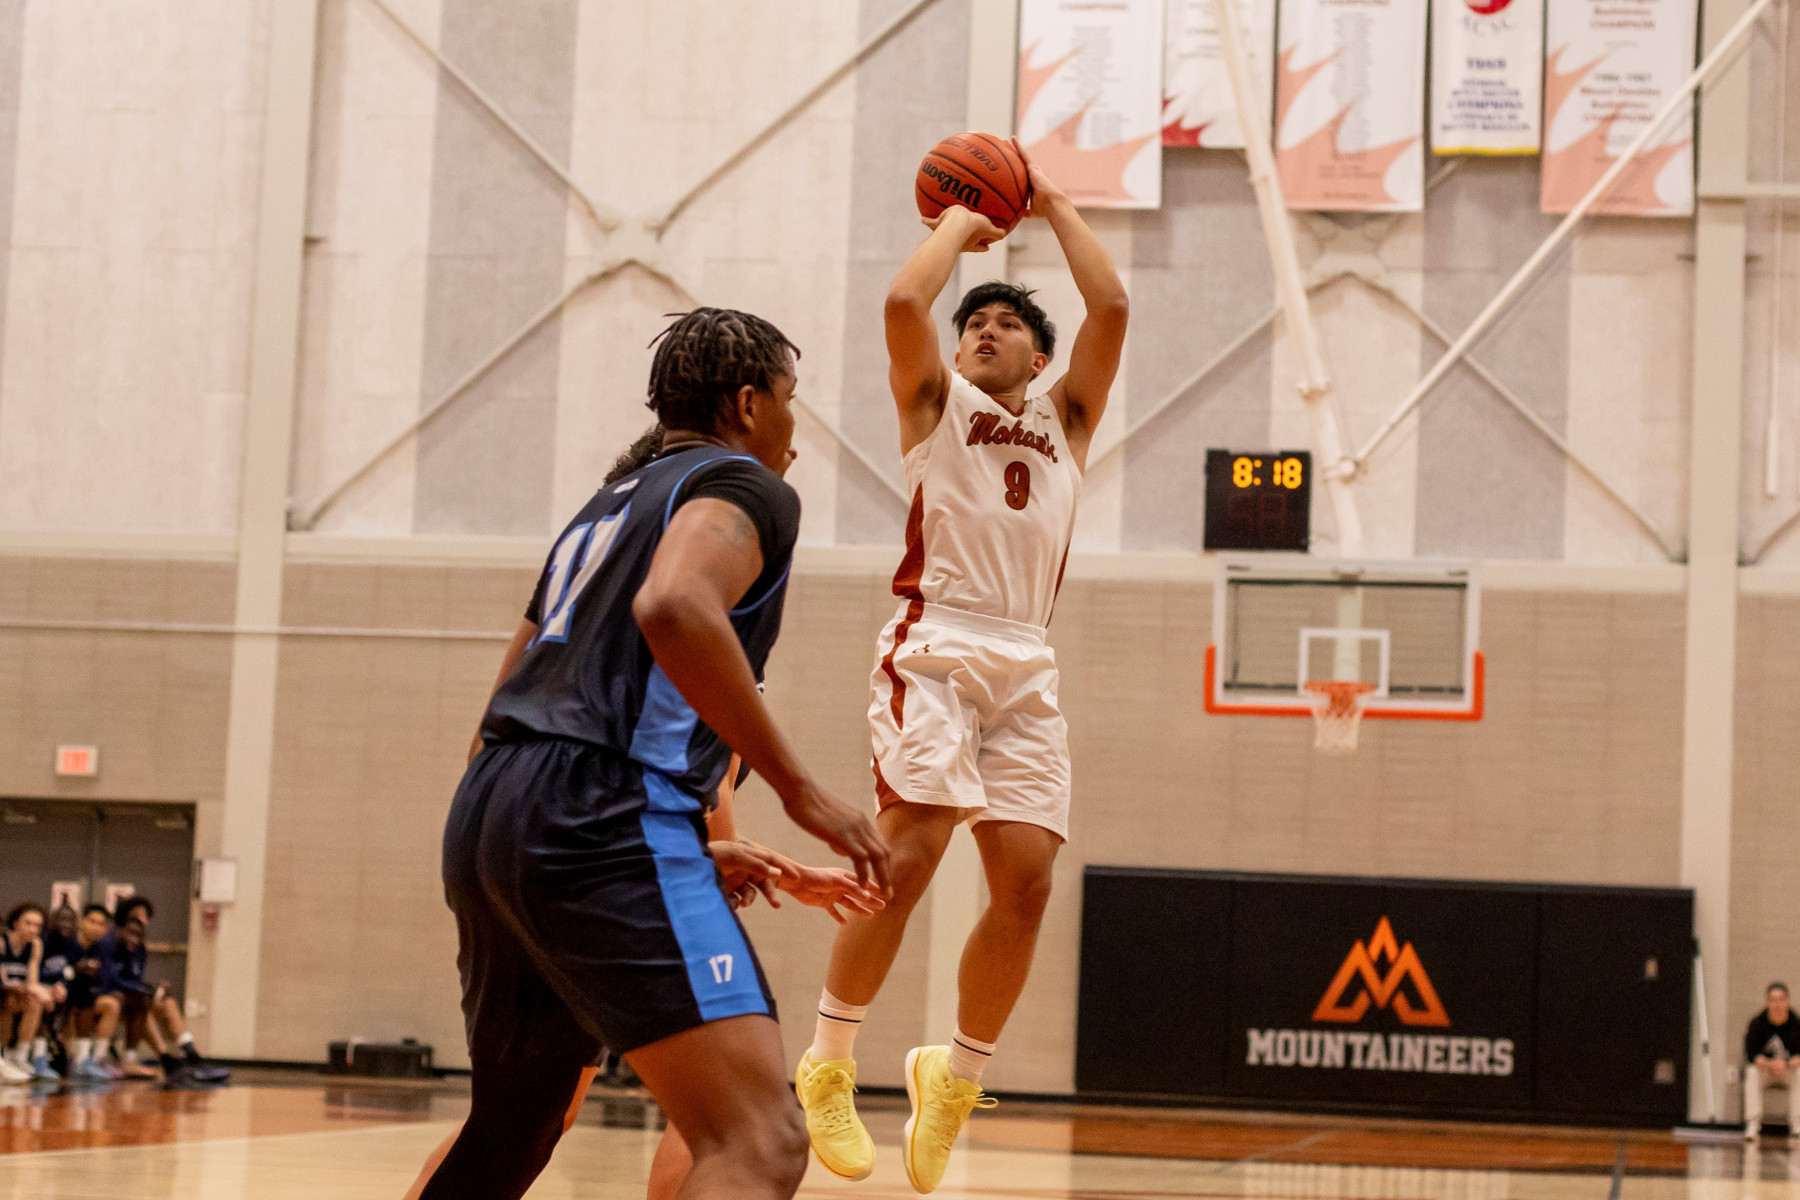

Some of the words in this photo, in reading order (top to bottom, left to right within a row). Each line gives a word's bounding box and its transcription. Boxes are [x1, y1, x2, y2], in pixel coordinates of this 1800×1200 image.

[922, 161, 982, 209] Wilson
[966, 411, 1058, 464] Mohawk
[1004, 461, 1030, 511] 9
[1232, 457, 1303, 490] 8:18
[708, 954, 733, 984] 17
[1246, 1028, 1515, 1076] MOUNTAINEERS
